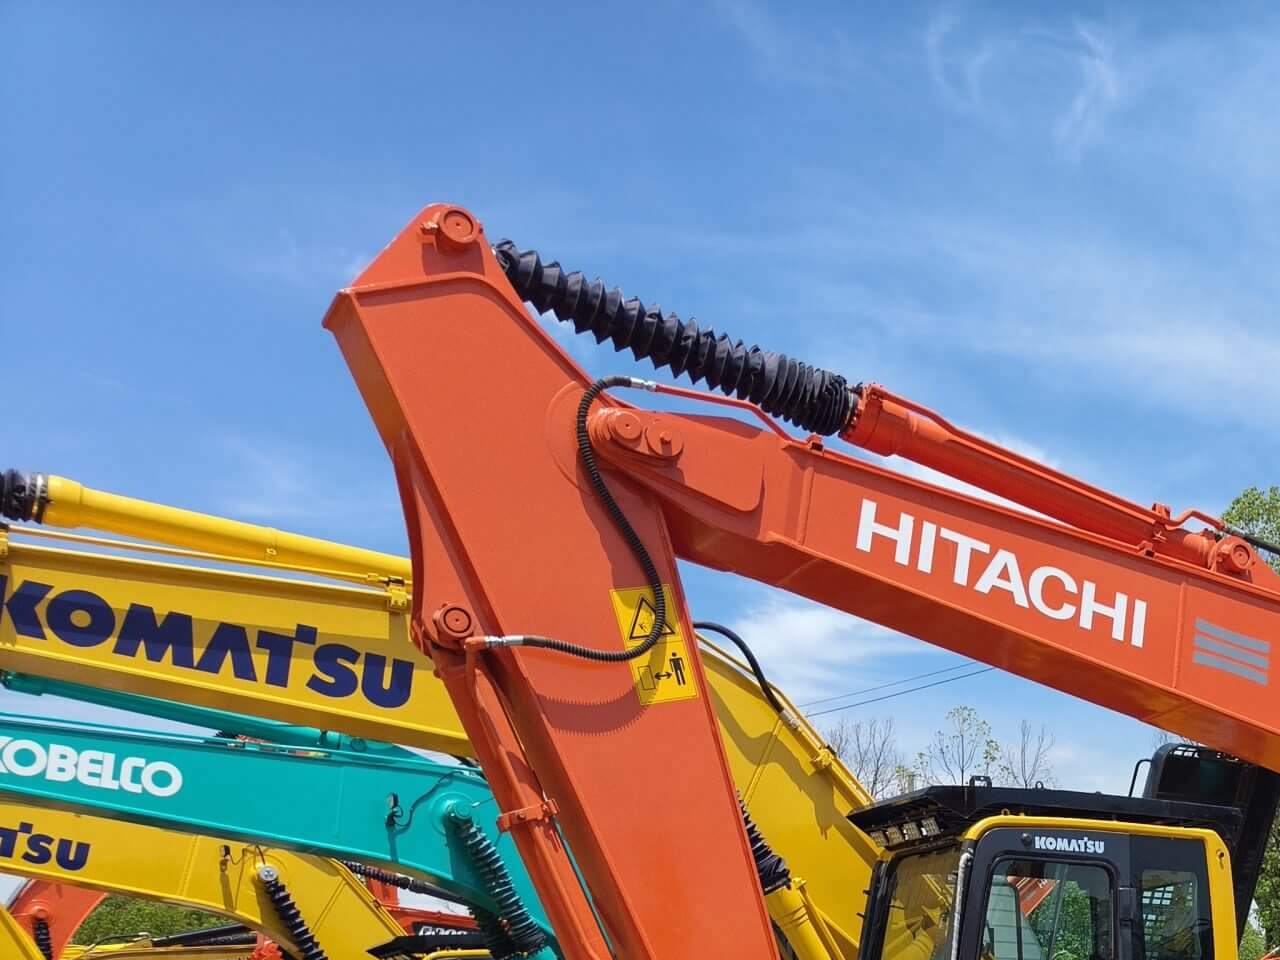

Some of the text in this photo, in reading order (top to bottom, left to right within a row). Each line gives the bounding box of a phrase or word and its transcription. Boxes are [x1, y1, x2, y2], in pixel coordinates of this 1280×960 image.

[855, 498, 1148, 648] HITACHI
[0, 574, 415, 709] KOMATSU
[1034, 836, 1105, 854] KOMATSU
